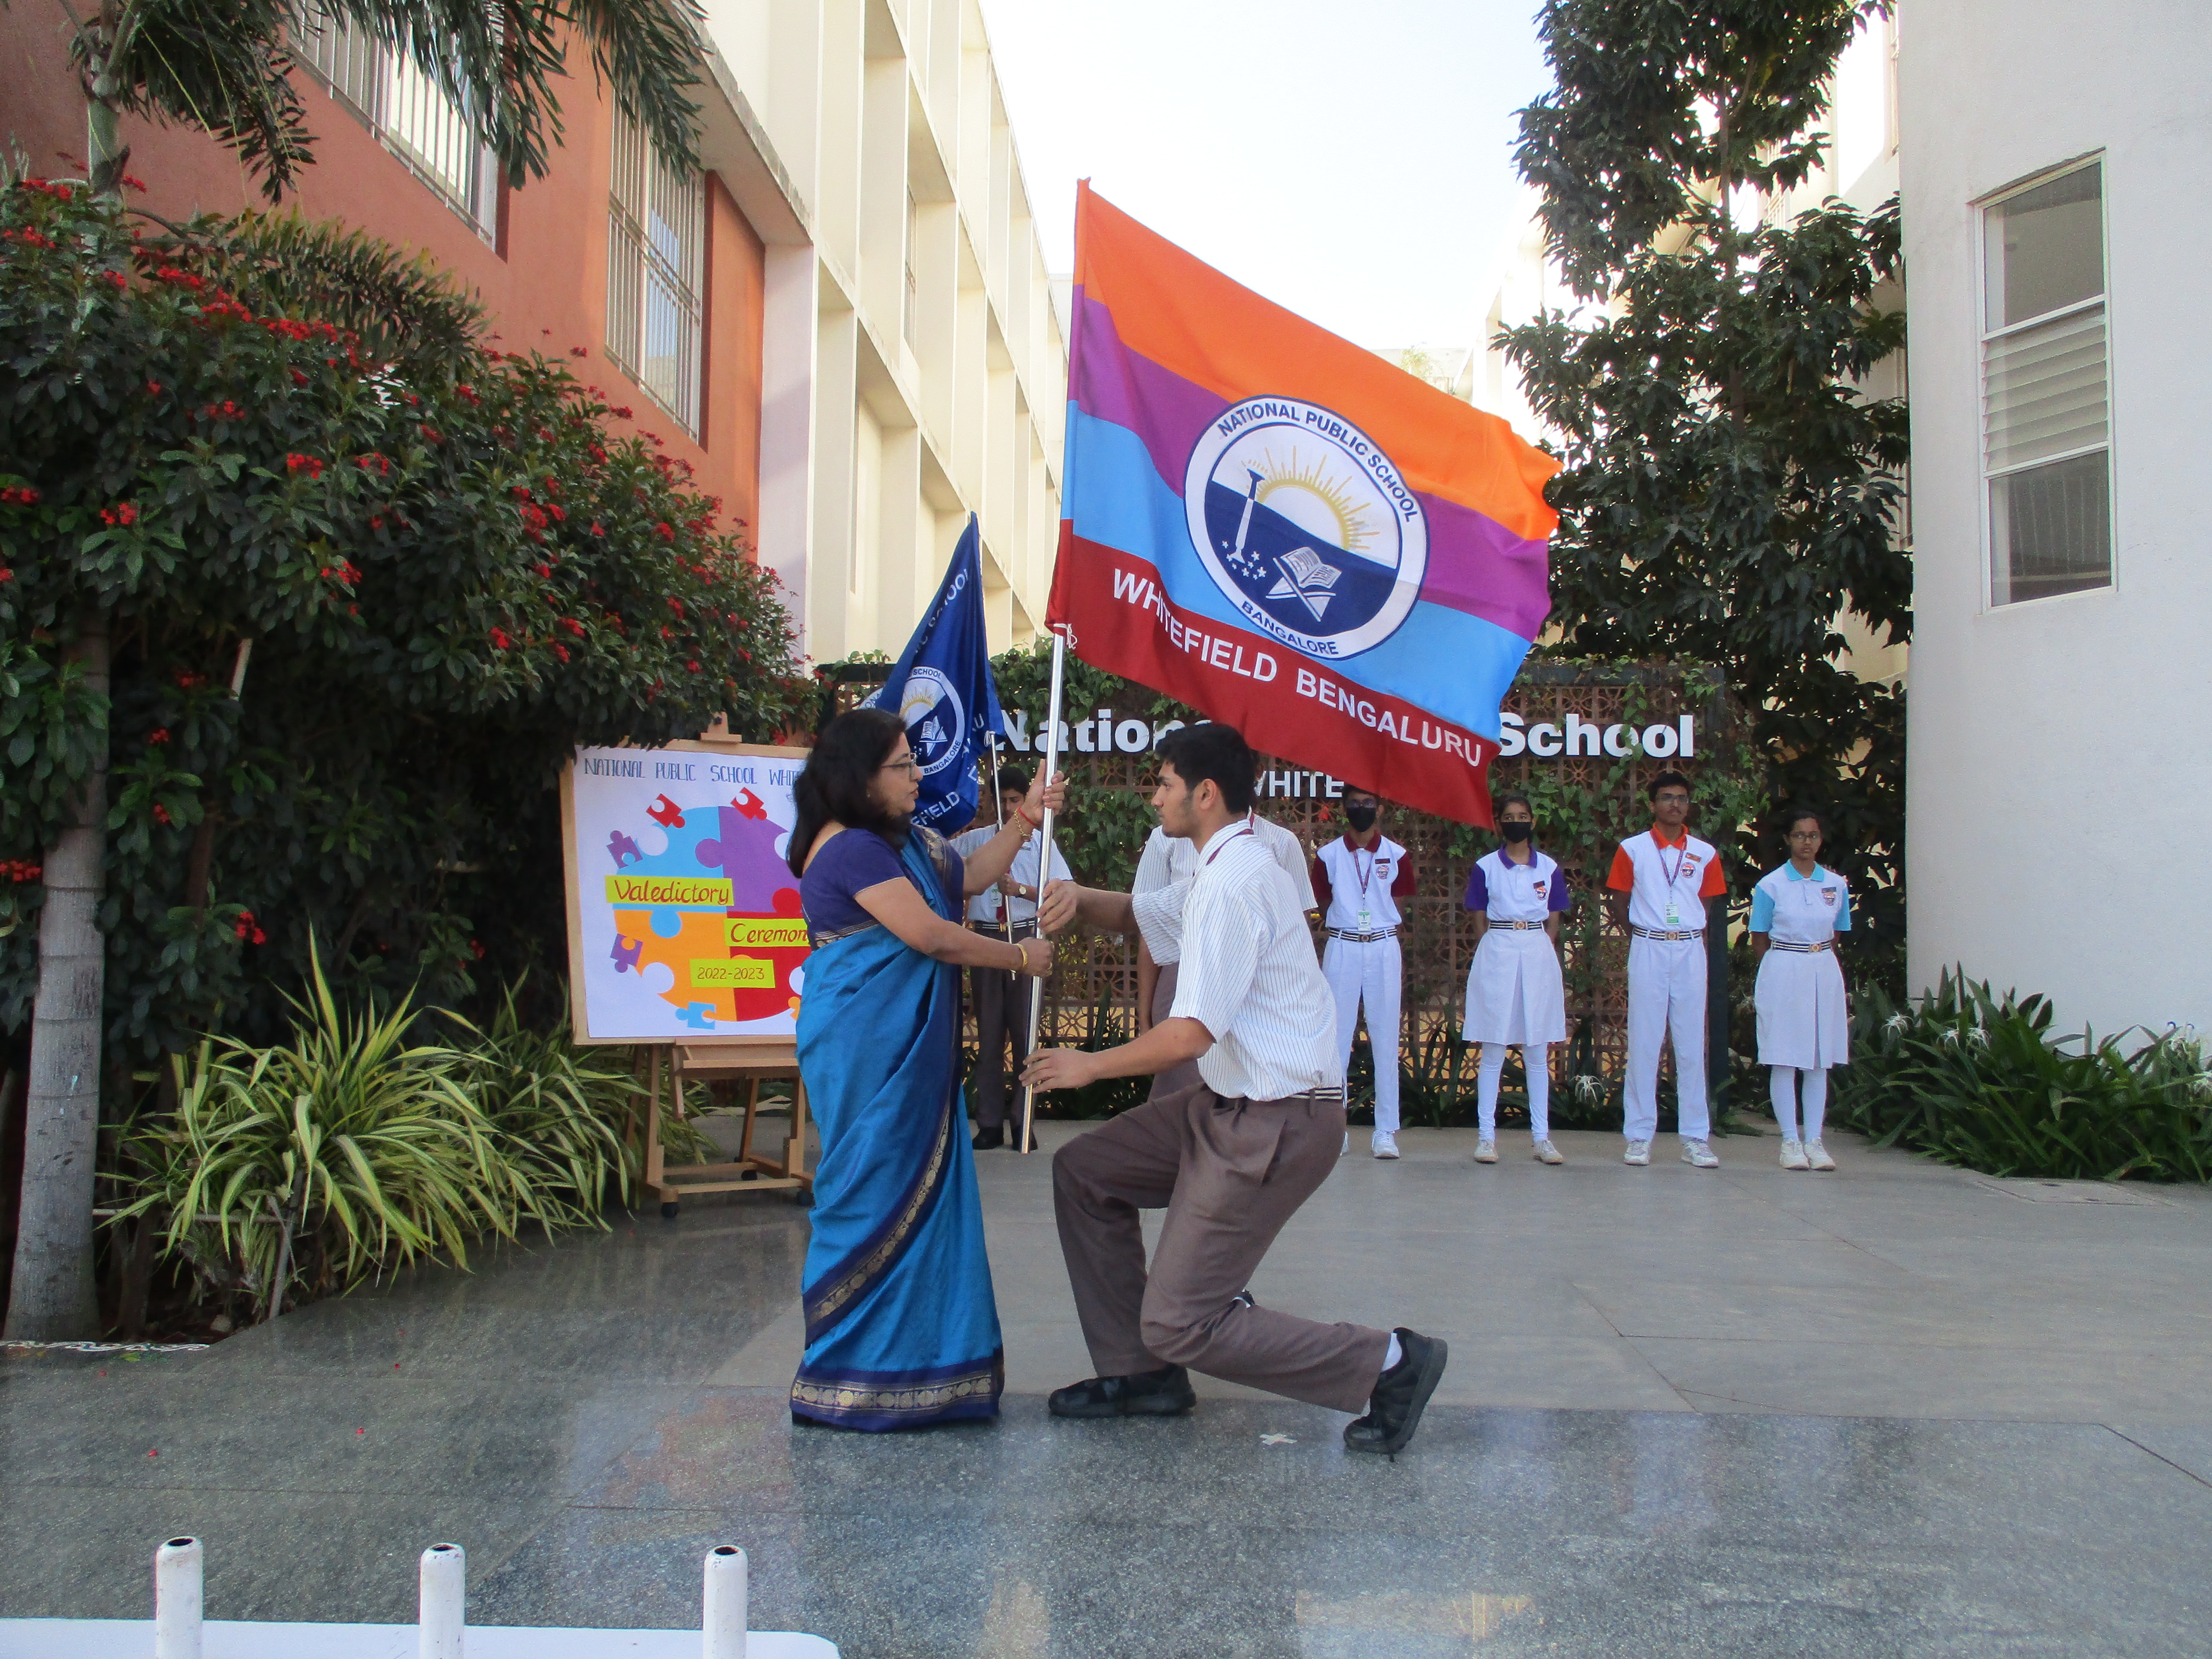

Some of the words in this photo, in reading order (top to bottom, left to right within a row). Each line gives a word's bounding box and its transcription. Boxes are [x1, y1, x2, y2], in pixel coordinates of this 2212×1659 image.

[1218, 402, 1300, 437] NATIONAL
[1305, 410, 1369, 456] PUBLIC
[1367, 454, 1418, 523] SCHOOL
[1241, 601, 1339, 655] BANGALORE
[913, 668, 942, 679] SCHOOL
[1114, 568, 1277, 682] WHITEFIELD
[1296, 668, 1481, 767] BENGALURU
[996, 709, 1212, 752] Natio
[1500, 712, 1694, 758] School
[584, 758, 645, 778] NATIONAL
[655, 762, 696, 781] PUBLIC
[710, 765, 757, 784] SCHOOL
[924, 740, 961, 774] BANGALORE
[614, 879, 729, 905] Valedictory
[731, 923, 808, 944] Ceremon
[697, 967, 765, 980] 2022-2023
